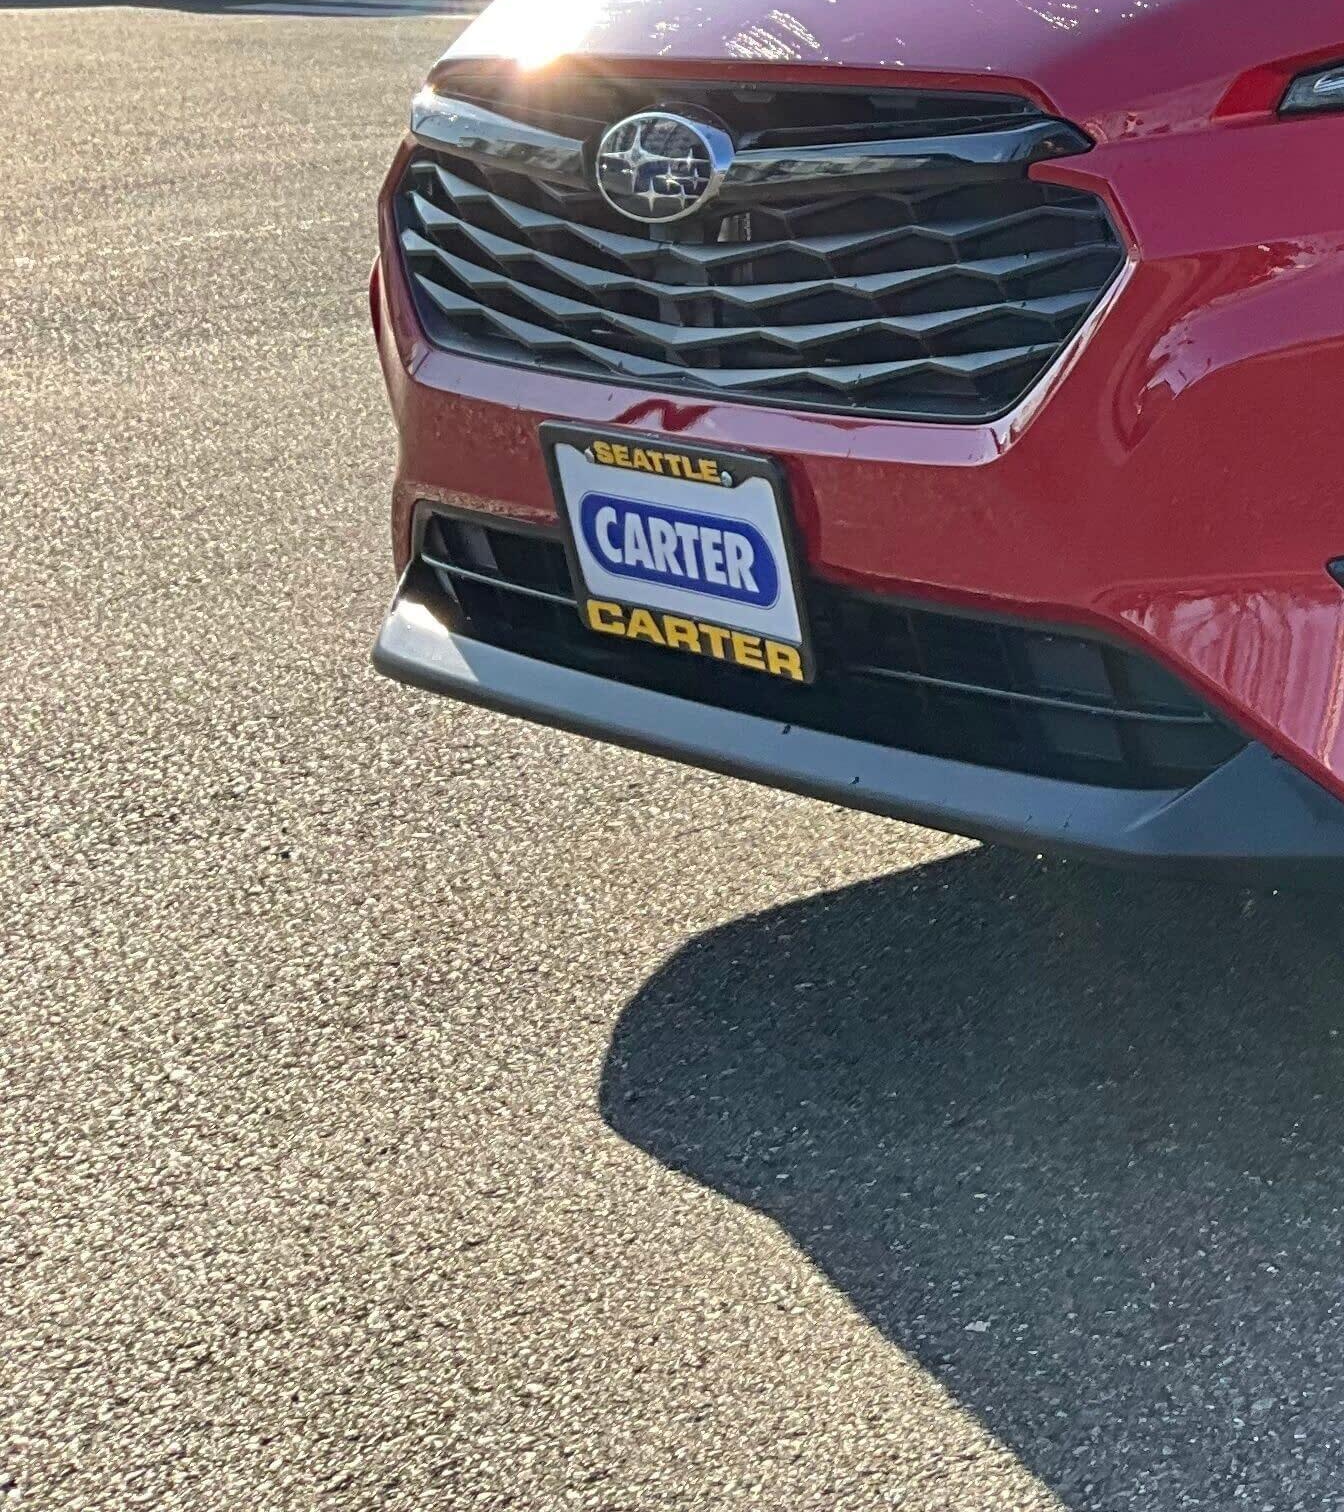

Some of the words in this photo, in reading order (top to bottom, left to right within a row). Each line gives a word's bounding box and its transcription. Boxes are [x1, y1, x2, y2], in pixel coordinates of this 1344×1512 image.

[592, 439, 722, 485] SEATTLE
[594, 505, 761, 594] CARTER
[585, 598, 805, 682] CARTER
